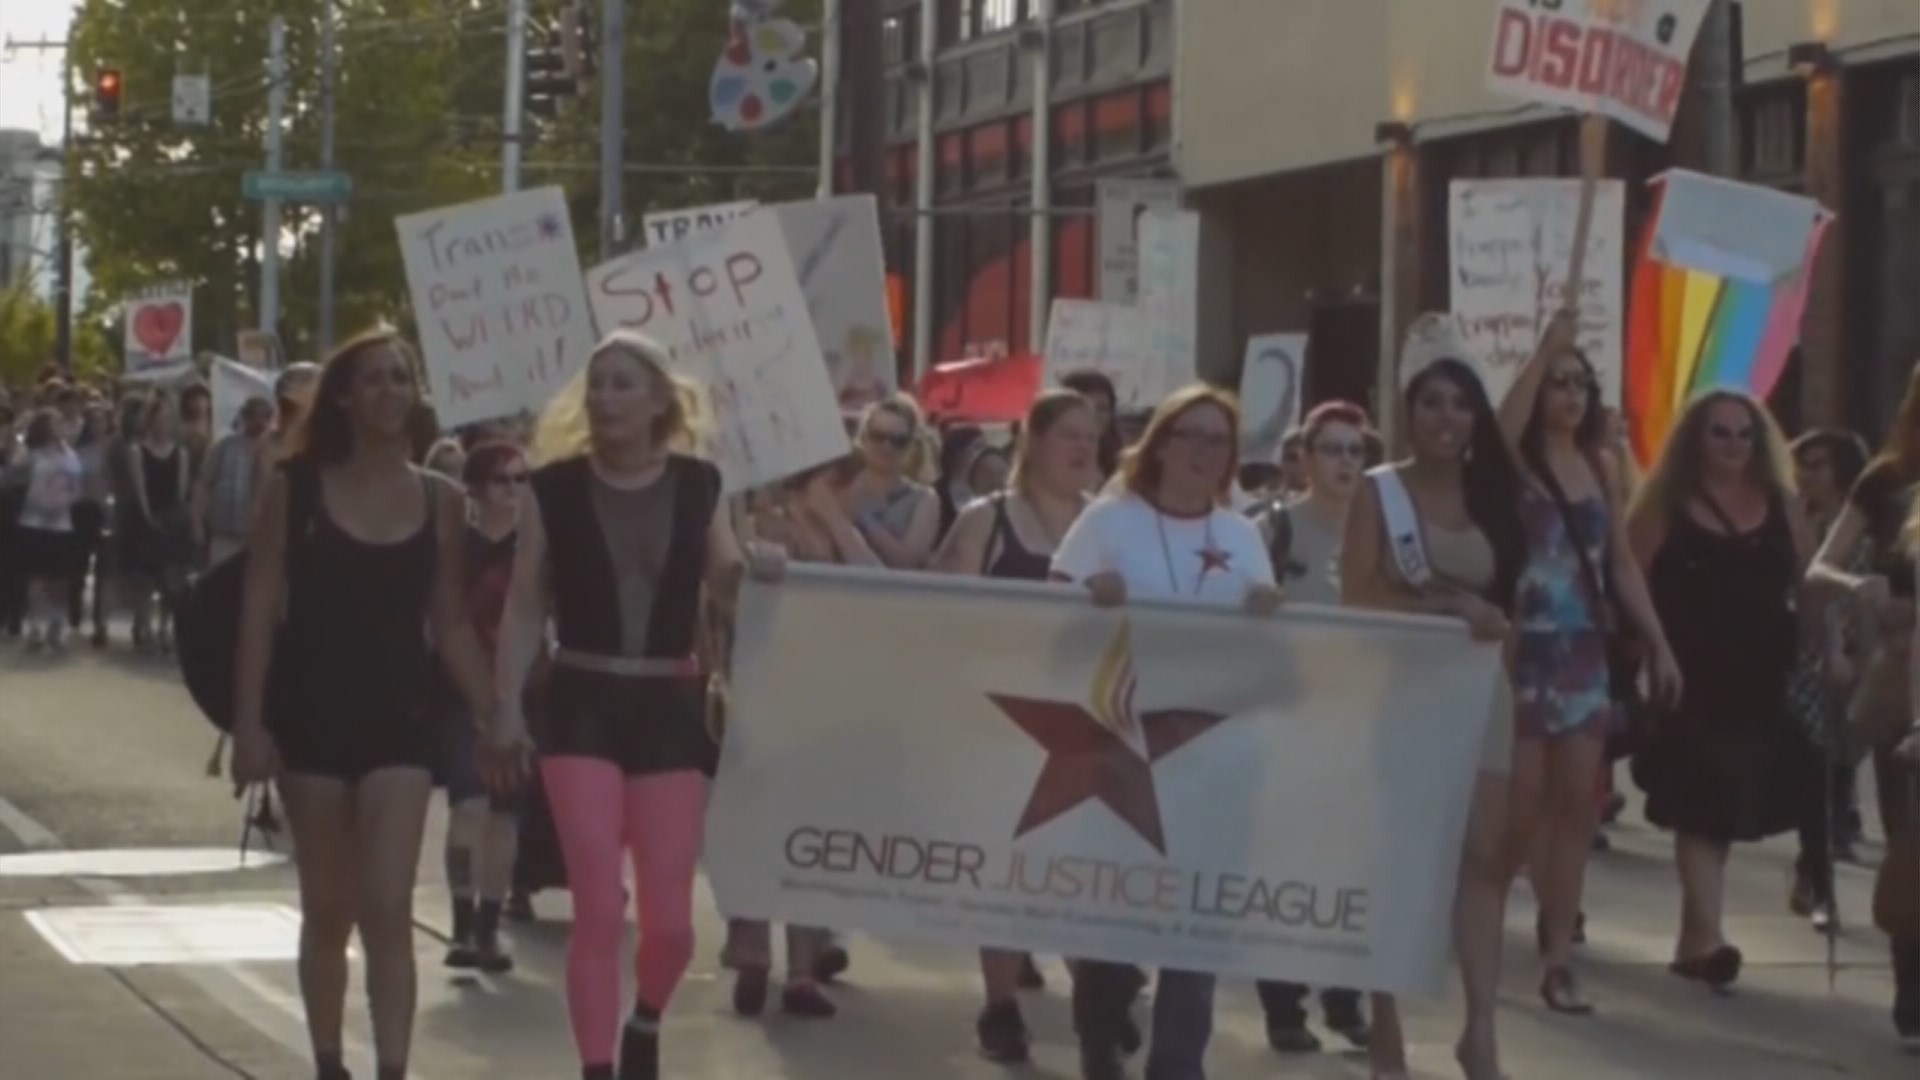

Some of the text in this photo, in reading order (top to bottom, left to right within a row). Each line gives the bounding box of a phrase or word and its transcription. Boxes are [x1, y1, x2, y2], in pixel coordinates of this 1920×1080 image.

[1492, 7, 1684, 126] DISORDER
[784, 826, 986, 890] GENDER
[990, 850, 1182, 913] JUSTICE
[1190, 870, 1369, 932] LEAGUE
